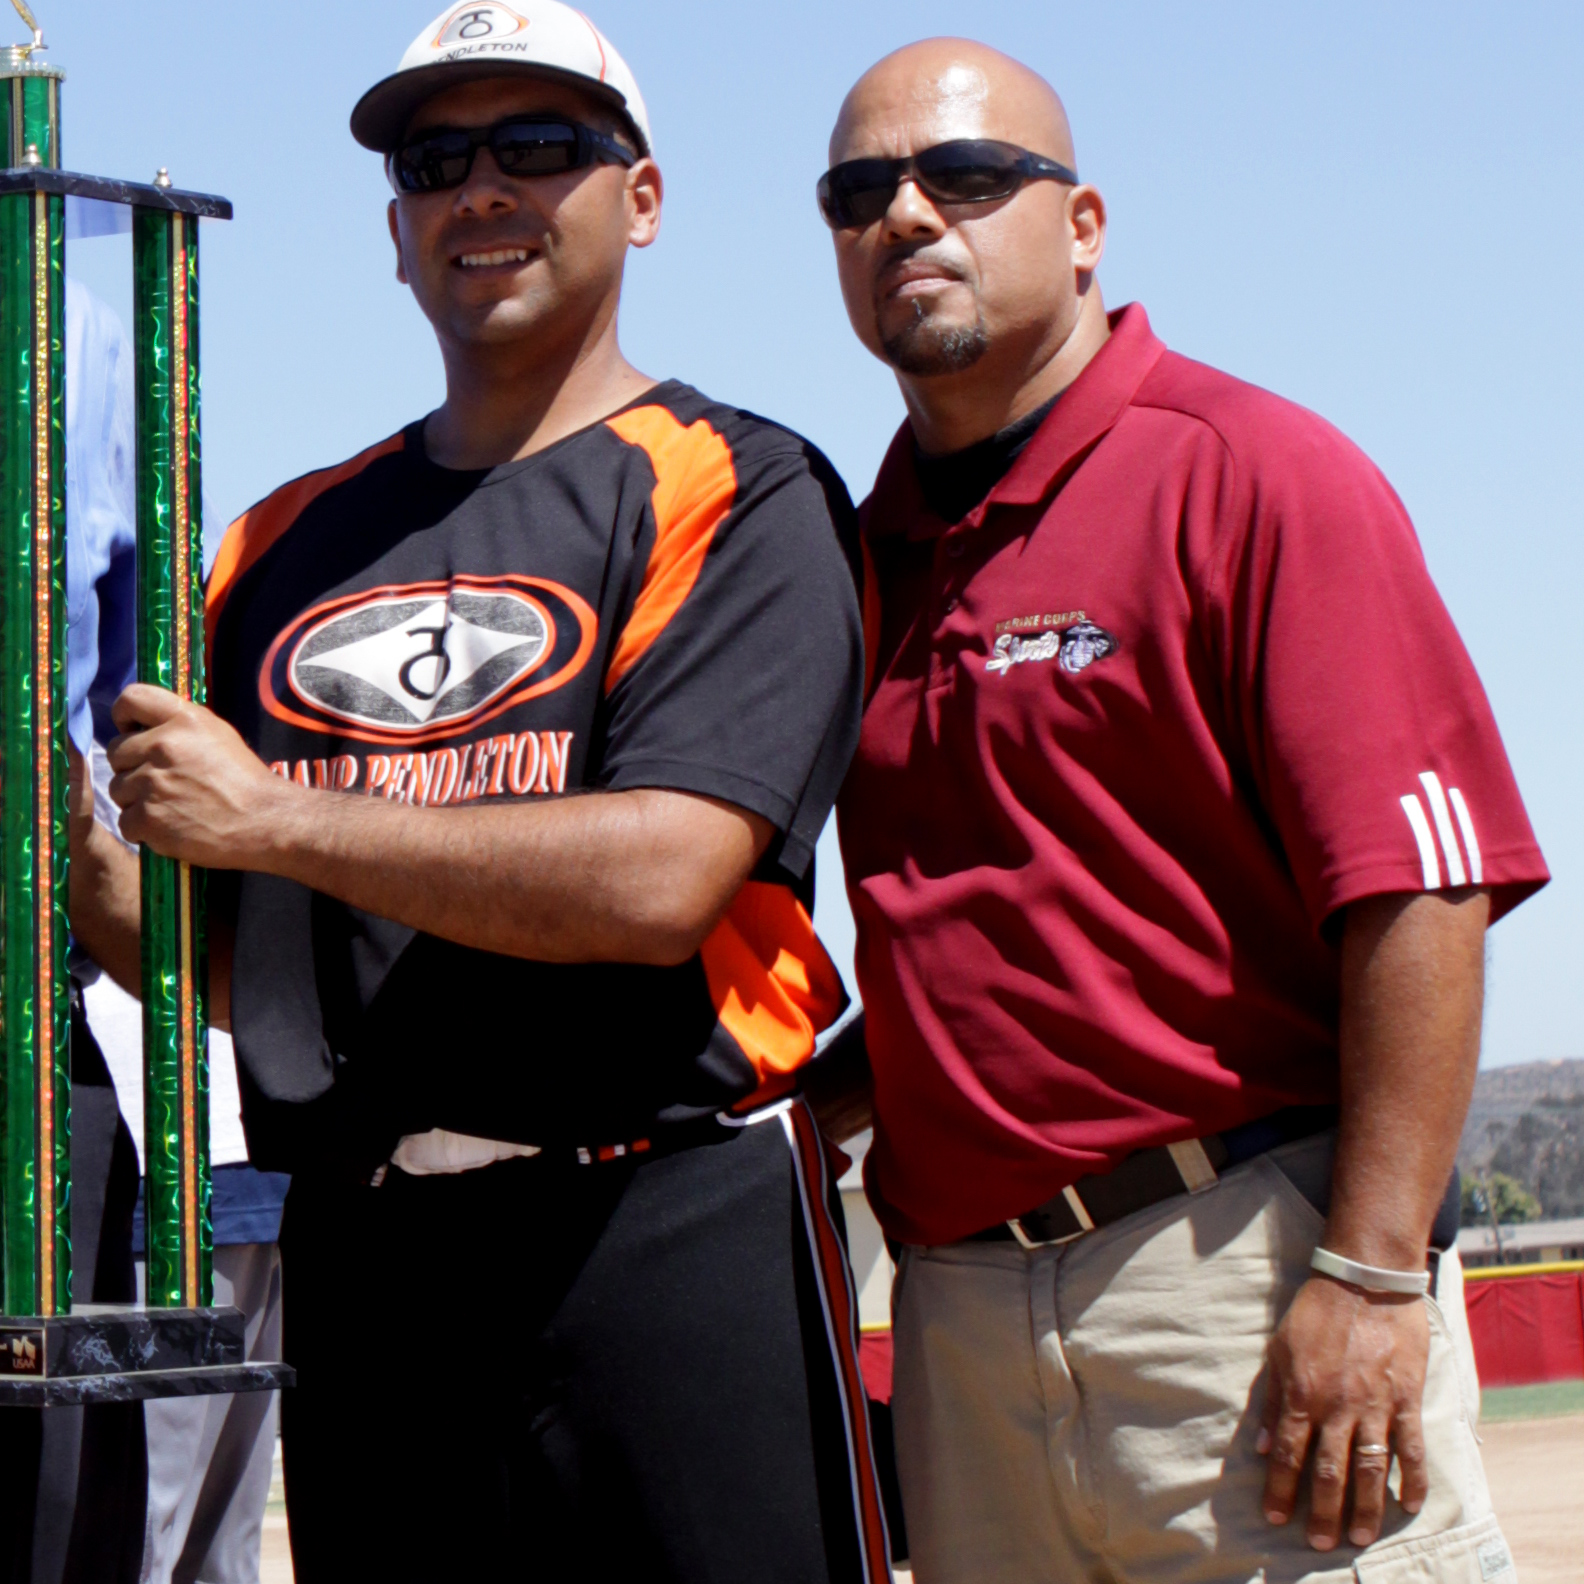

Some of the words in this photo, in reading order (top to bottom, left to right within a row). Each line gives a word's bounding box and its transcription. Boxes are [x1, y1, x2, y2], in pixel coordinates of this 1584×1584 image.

[433, 43, 529, 63] ENDLETON
[995, 615, 1040, 633] MARINE
[1043, 610, 1086, 626] CORPS
[366, 731, 573, 807] PENDLETON
